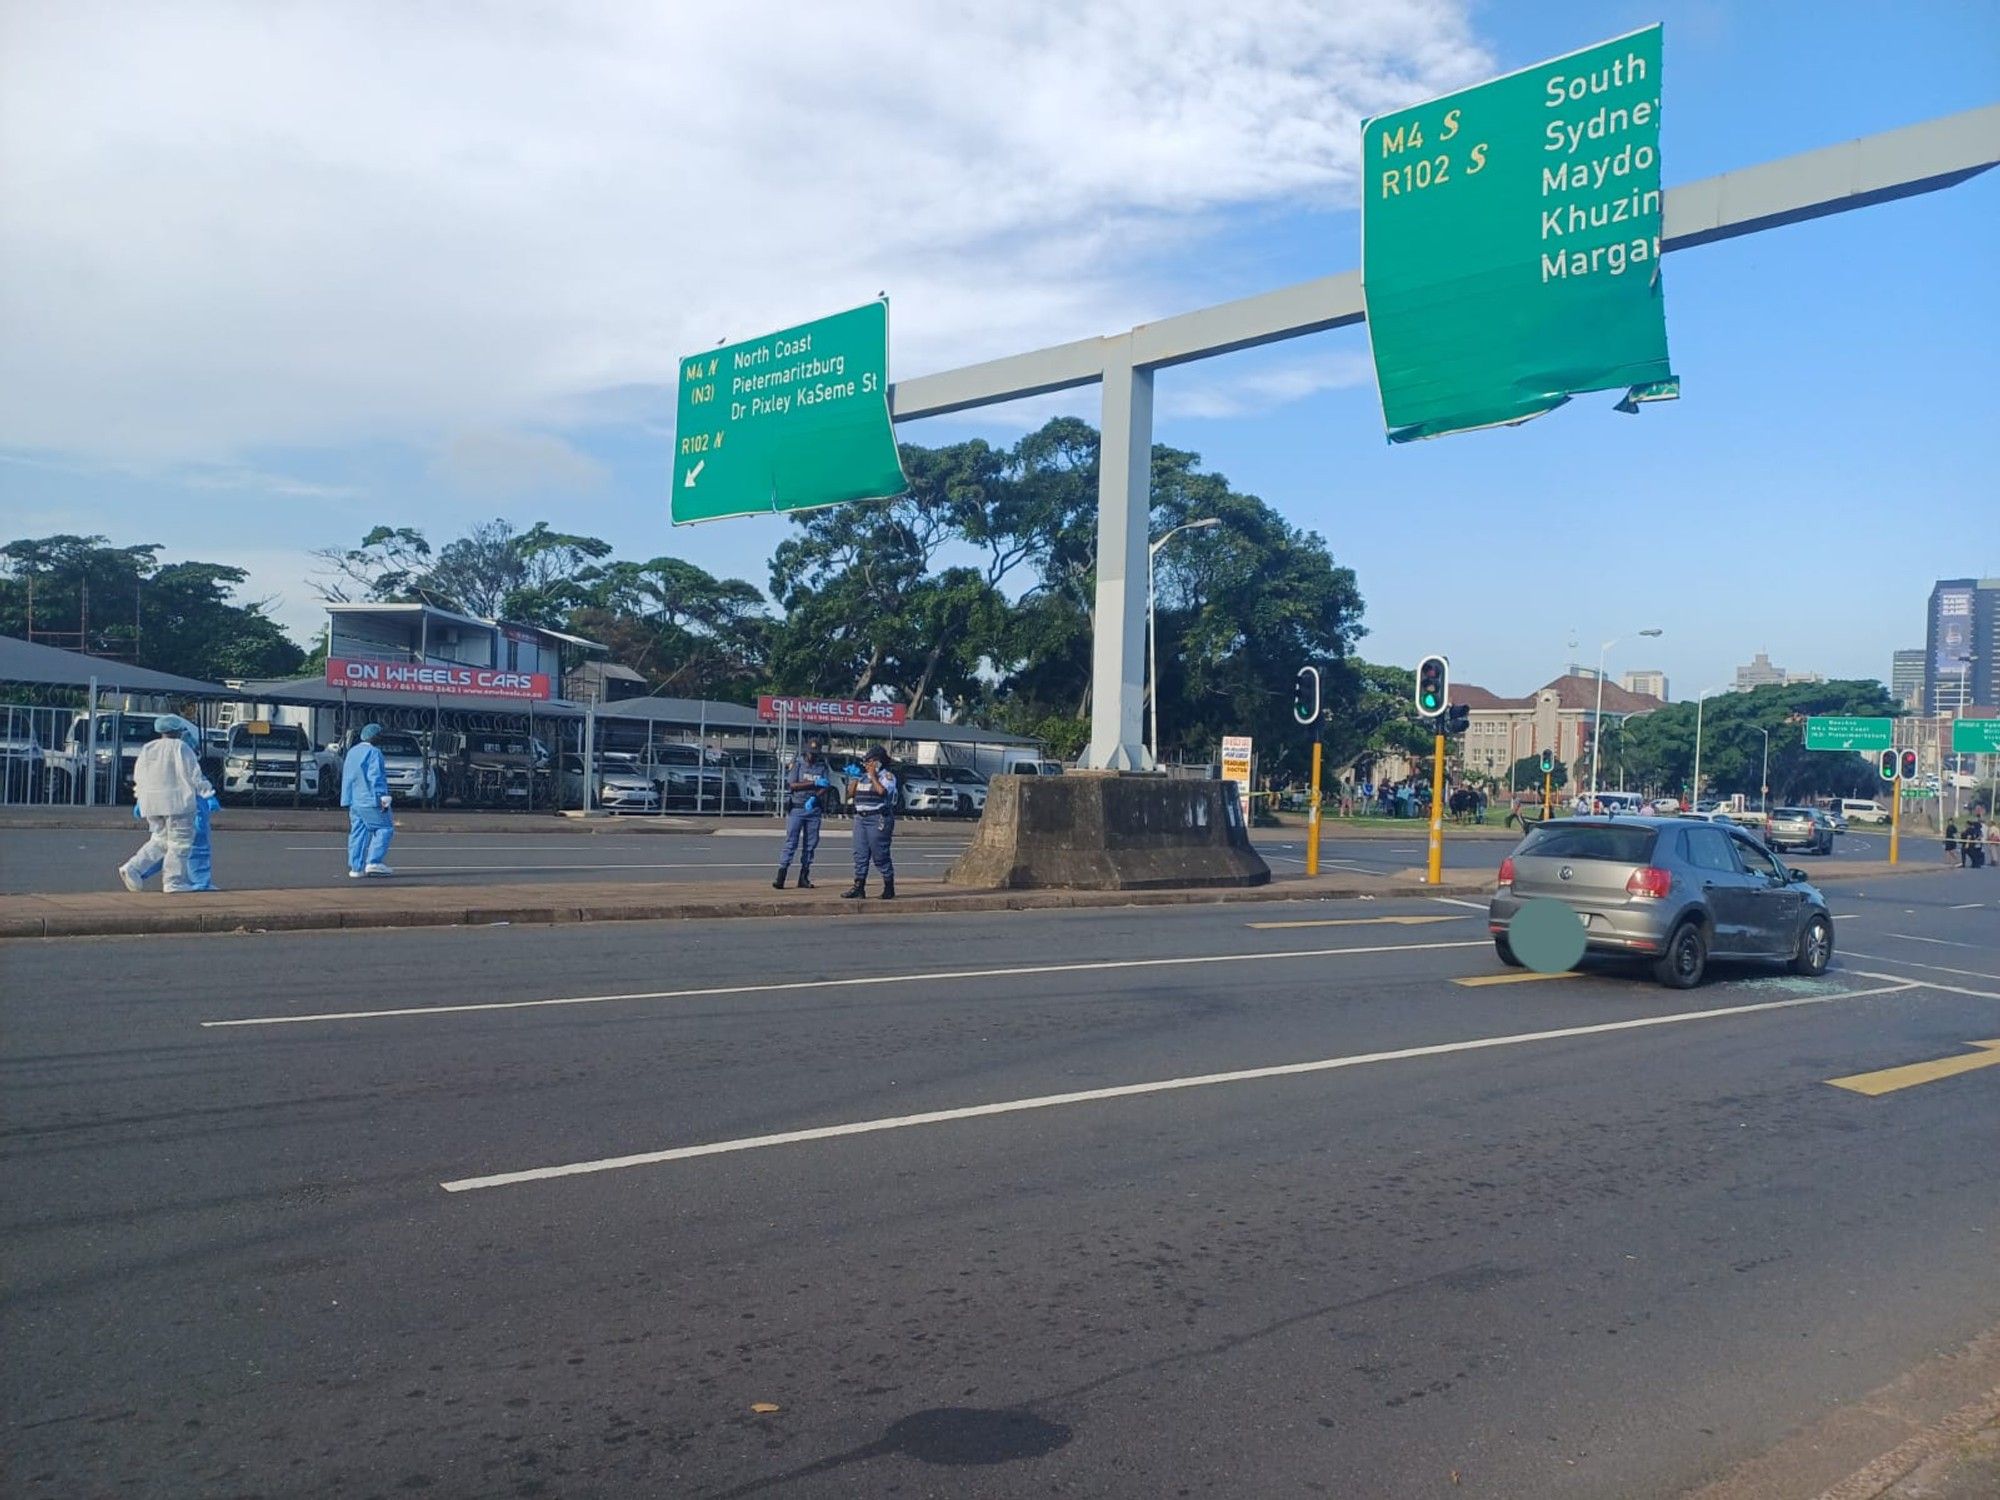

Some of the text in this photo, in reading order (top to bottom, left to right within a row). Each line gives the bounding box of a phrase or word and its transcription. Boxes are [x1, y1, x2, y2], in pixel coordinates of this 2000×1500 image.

[1544, 53, 1646, 107] South
[1382, 109, 1461, 159] M4 S
[1544, 98, 1659, 155] Sydne
[1382, 143, 1488, 199] R102 S
[1542, 144, 1653, 196] Maydo
[1542, 187, 1660, 240] Khuzin
[686, 358, 719, 382] M4 N
[733, 333, 812, 370] North Coast
[691, 383, 715, 406] (N3)
[731, 372, 878, 421] Dr Pixley KaSeme St
[732, 356, 844, 395] Pietermaritzburg
[682, 430, 725, 455] R102 N
[346, 663, 532, 689] ON WHEELS CARS
[772, 700, 793, 711] ON
[798, 700, 854, 716] WHEELS
[858, 704, 894, 718] CARS
